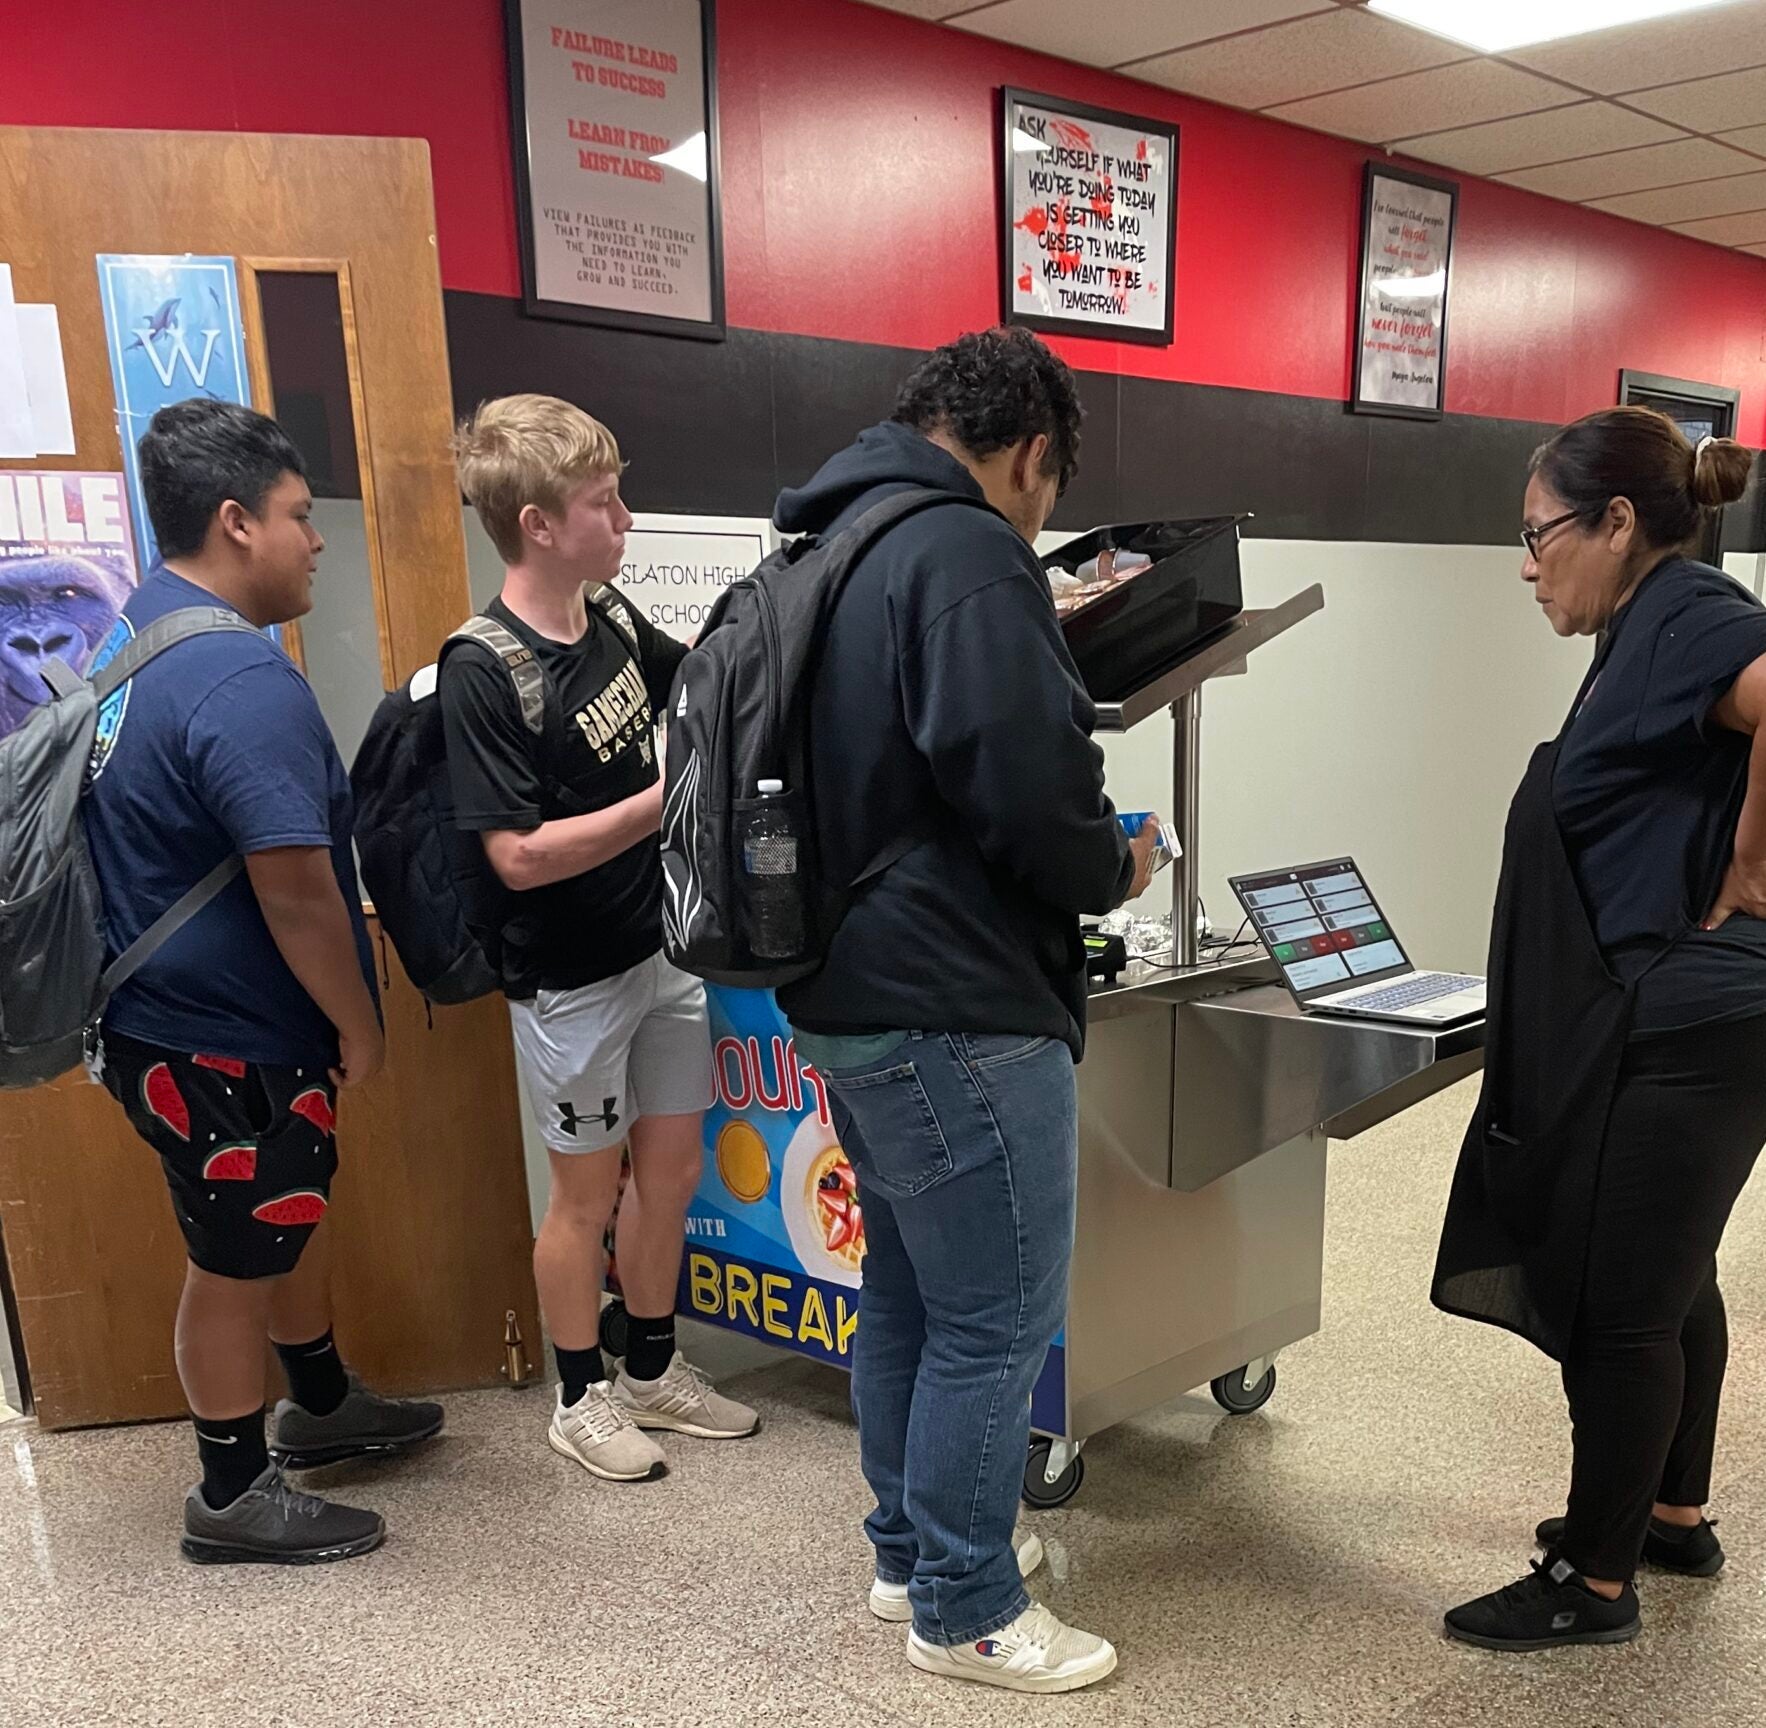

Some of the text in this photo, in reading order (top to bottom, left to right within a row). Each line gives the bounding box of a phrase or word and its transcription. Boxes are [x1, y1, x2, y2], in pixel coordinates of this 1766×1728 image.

[551, 26, 678, 74] FAILURE LEADS
[572, 60, 666, 99] TO SUCCESS
[568, 118, 671, 154] LEARN FROM
[1019, 114, 1046, 139] ASK
[1103, 155, 1114, 174] IF
[1117, 158, 1152, 182] WHAT
[1028, 169, 1156, 218] YOU'RE DOING TODAY
[543, 208, 696, 244] VIEW FAILURES AS FEEDBACK
[1046, 201, 1140, 242] IS GETTING YOU
[554, 224, 689, 256] THAT PROVIDES YOU WITH
[565, 240, 681, 269] THE INFORMATION YOU
[1038, 230, 1147, 263] CLOSER TO WHERE
[582, 257, 607, 271] NEED
[614, 261, 625, 273] TO
[1042, 259, 1142, 290] YOU WANT TO BE
[576, 270, 678, 295] GROW AND SUCCEED.
[1058, 289, 1125, 315] TOMORROW.
[621, 563, 746, 586] SLATON HIGH
[684, 1216, 727, 1238] WITH
